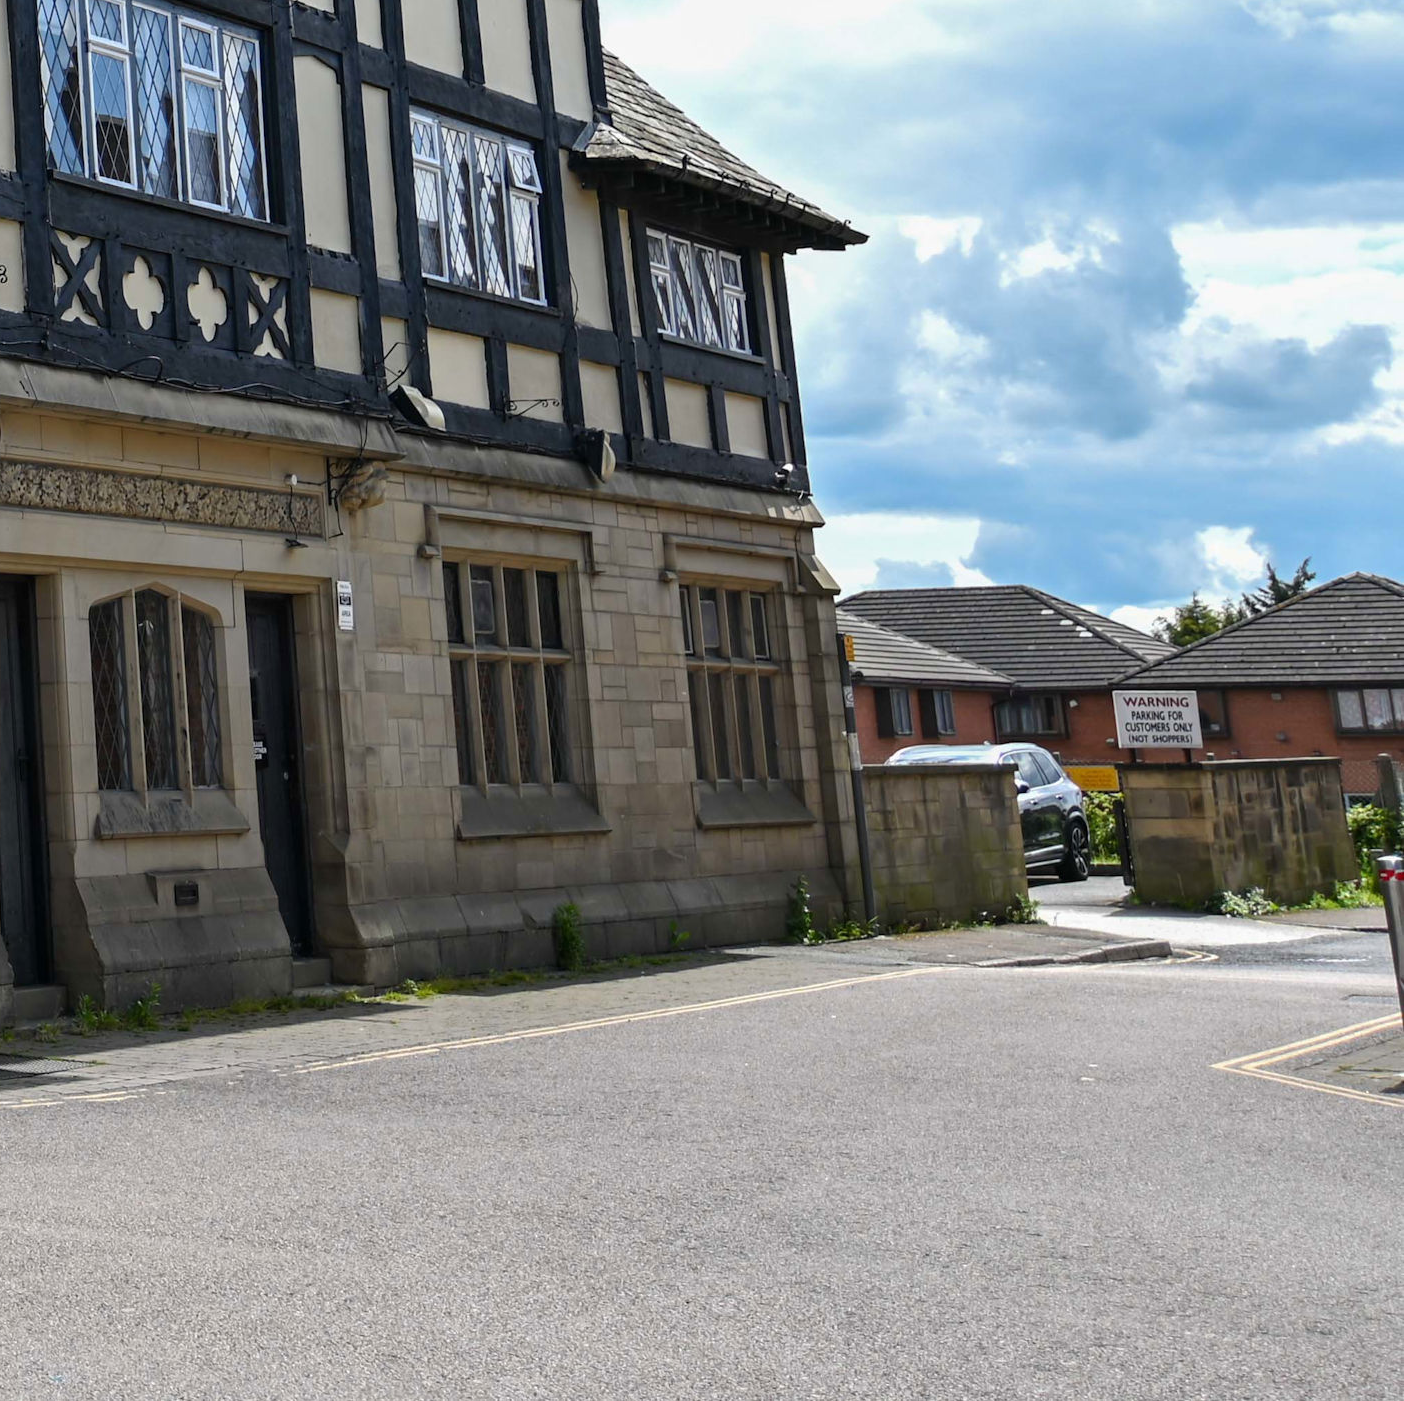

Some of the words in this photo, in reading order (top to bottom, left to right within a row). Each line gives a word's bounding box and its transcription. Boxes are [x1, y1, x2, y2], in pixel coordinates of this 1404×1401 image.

[1122, 697, 1189, 708] WARNING
[1131, 711, 1165, 721] PARKING
[1168, 711, 1183, 721] FOR
[1125, 723, 1170, 732] CUSTOMERS
[1173, 723, 1193, 732] ONLY
[1128, 735, 1148, 744] (NOT
[1152, 735, 1193, 744] SHOPPERS)
